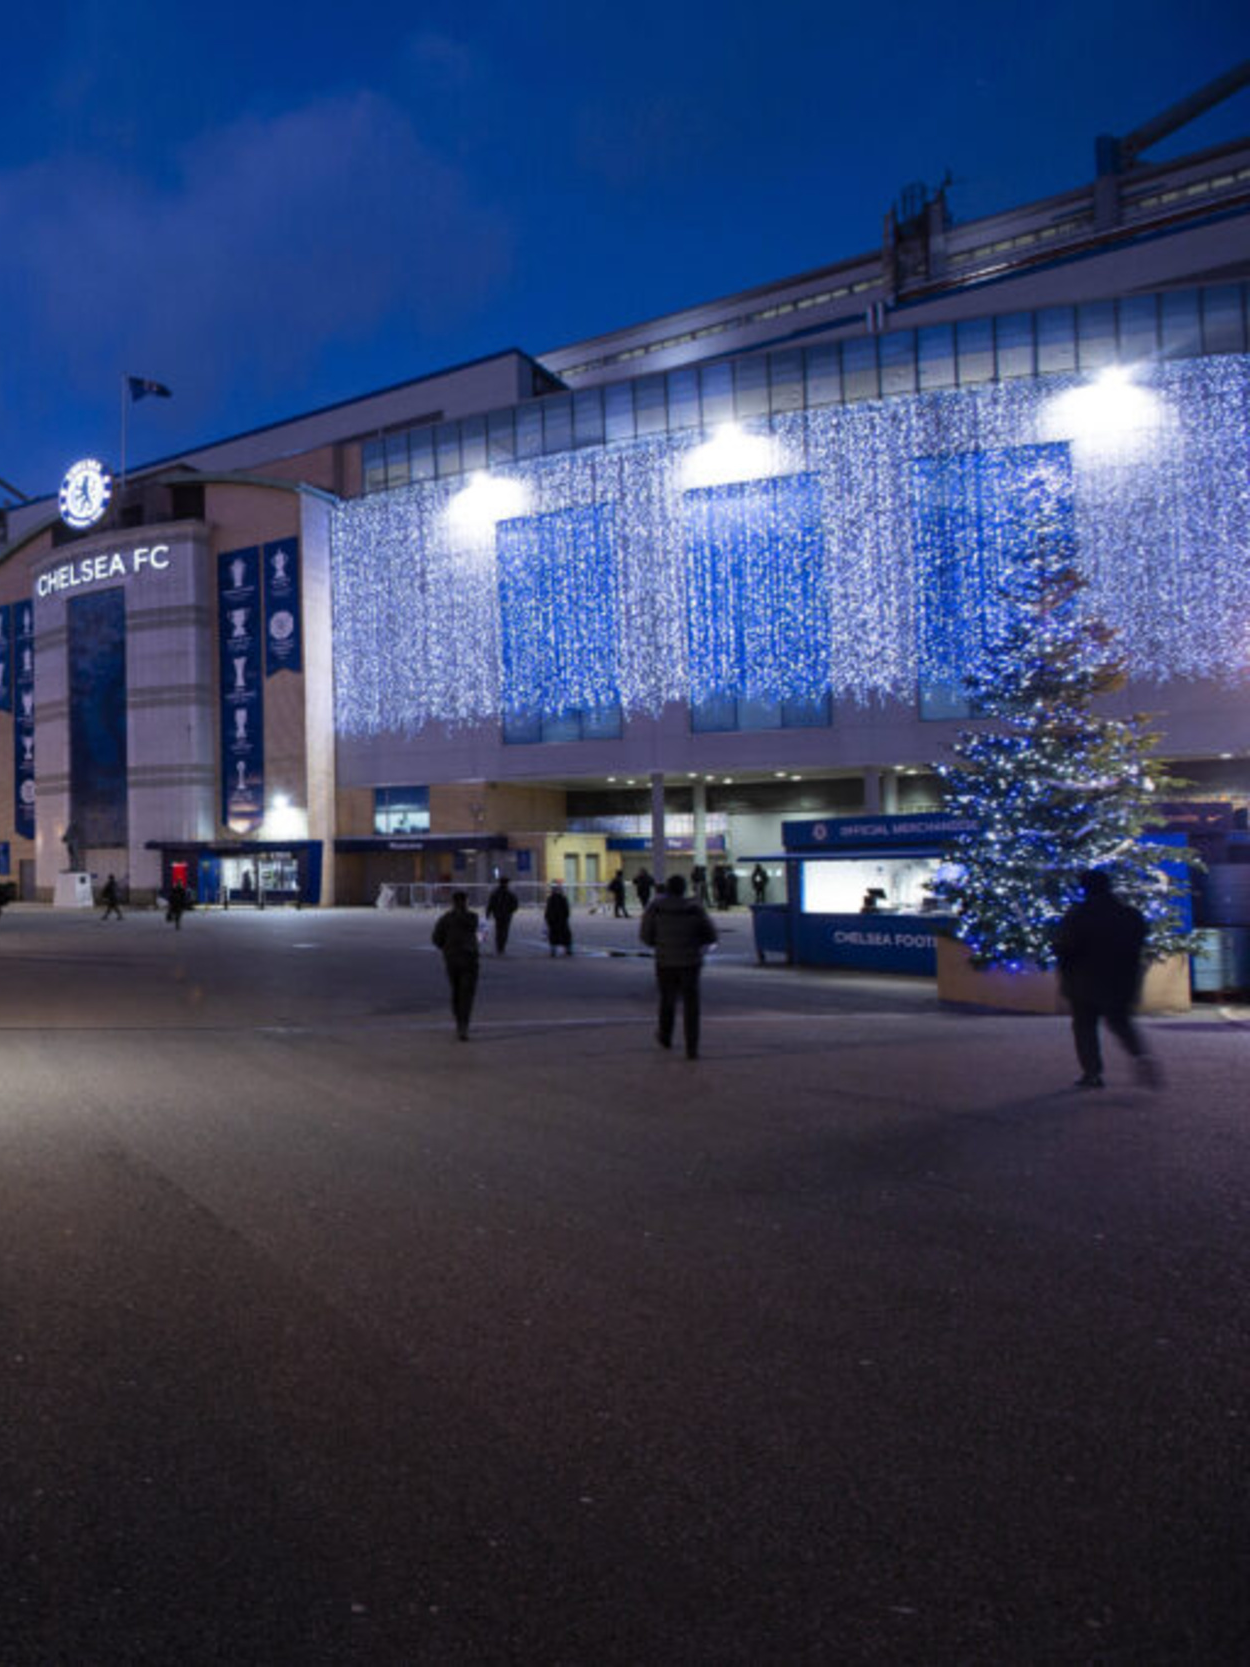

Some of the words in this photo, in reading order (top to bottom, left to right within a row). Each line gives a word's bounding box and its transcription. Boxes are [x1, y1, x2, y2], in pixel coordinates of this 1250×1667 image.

[37, 553, 126, 596] CHELSEA
[133, 545, 170, 572] FC
[833, 931, 893, 946] CHELSEA
